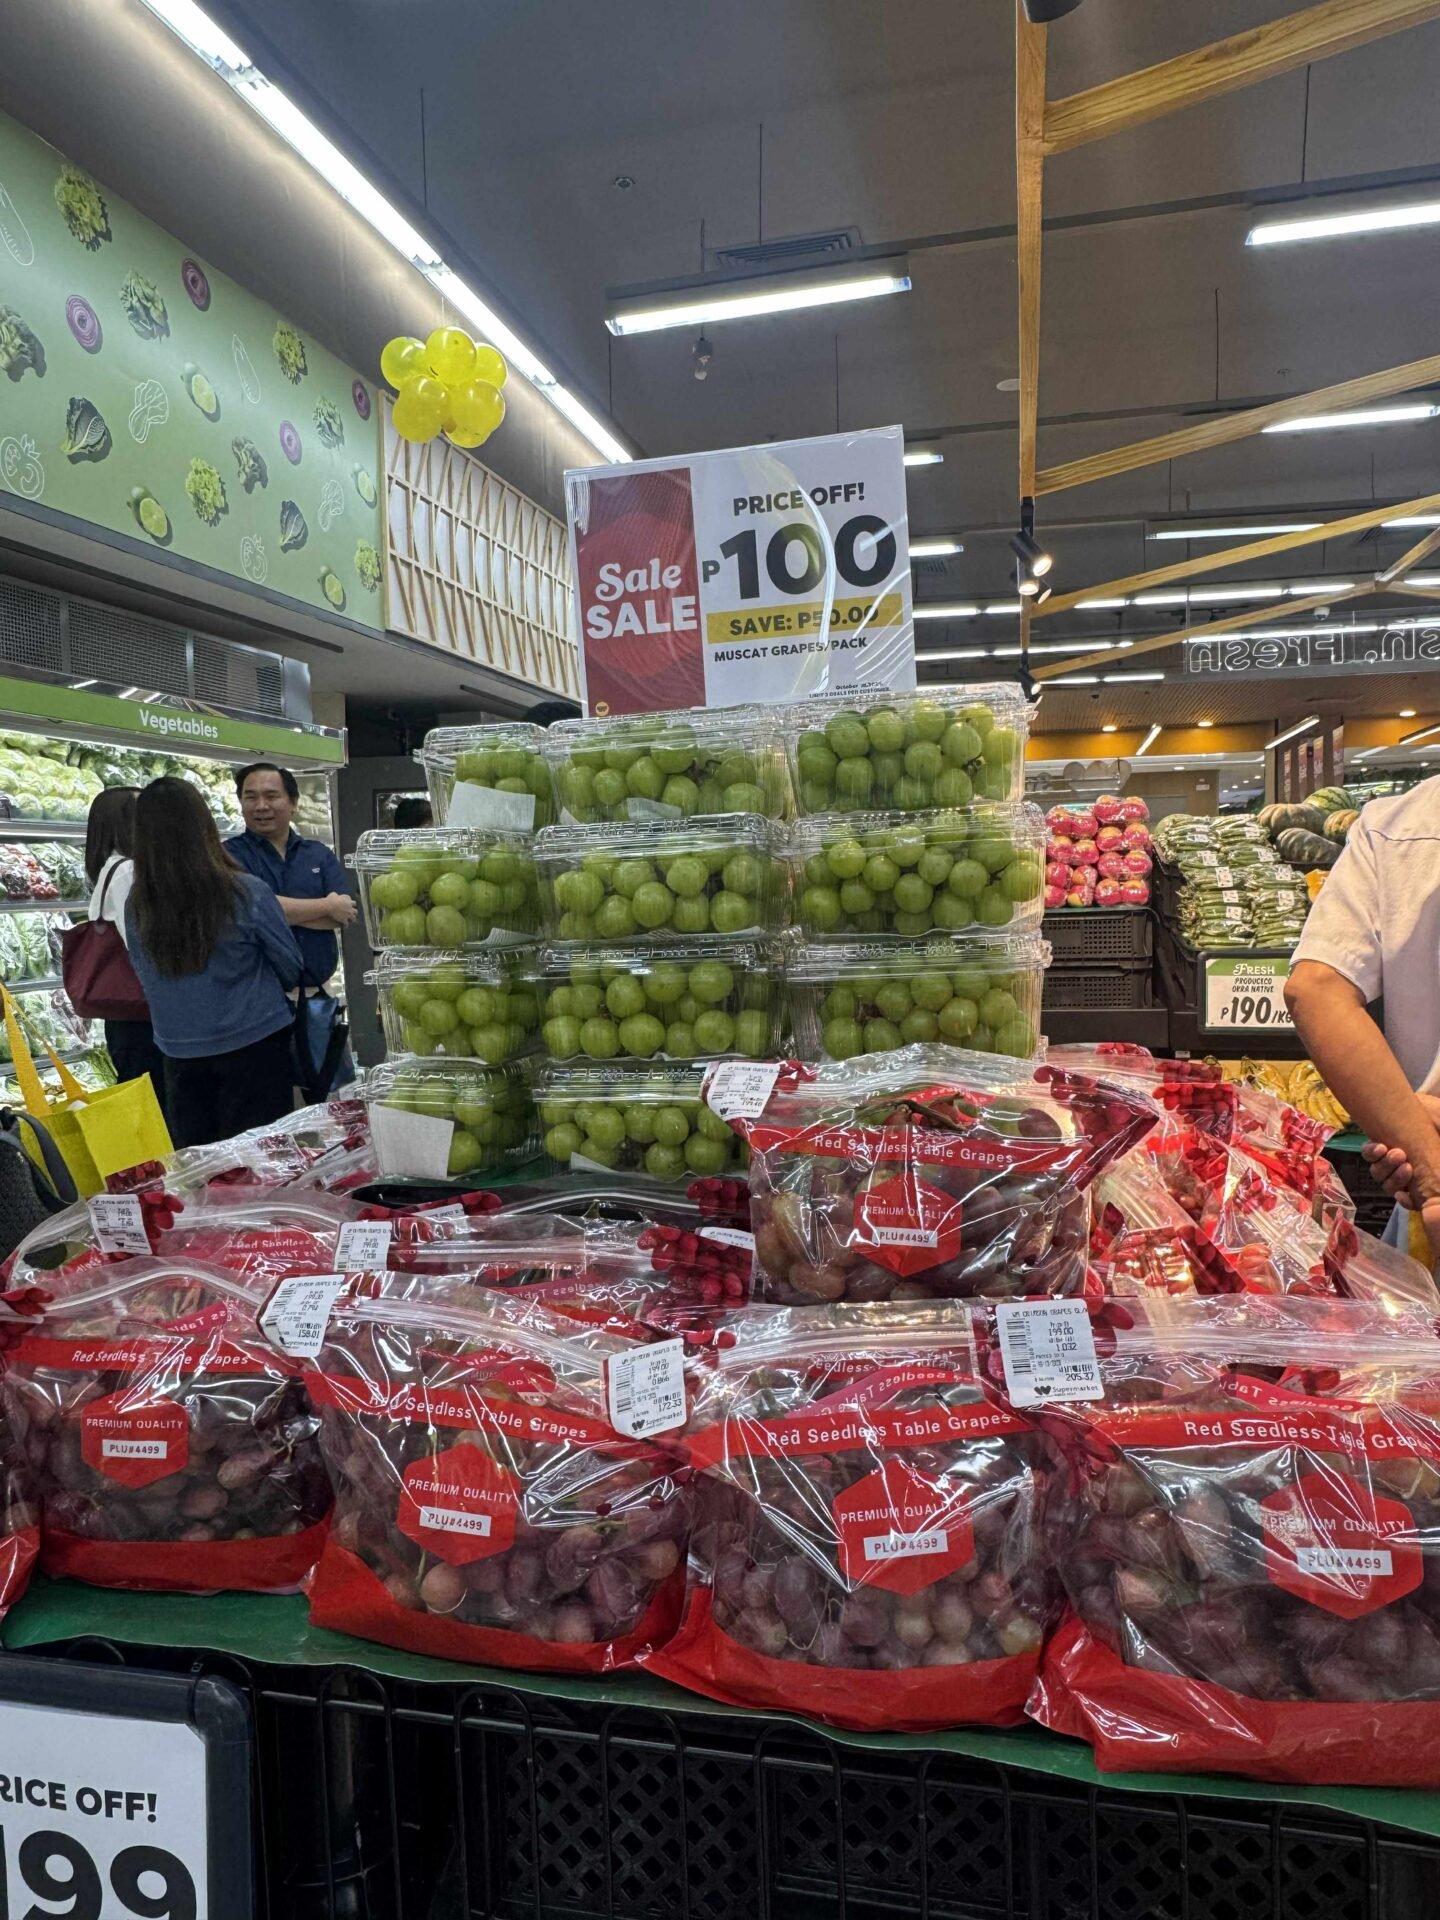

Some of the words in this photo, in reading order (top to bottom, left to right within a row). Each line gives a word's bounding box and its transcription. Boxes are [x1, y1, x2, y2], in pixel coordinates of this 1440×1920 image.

[733, 490, 804, 516] PRICE
[810, 482, 865, 506] OFF!
[596, 558, 682, 602] Sale
[587, 596, 698, 640] SALE
[730, 614, 792, 636] SAVE:
[714, 647, 768, 662] MUSCAT
[771, 637, 868, 656] GRAPES/PACK
[139, 709, 218, 738] Vegetables
[1232, 985, 1250, 993] OKRA
[1250, 985, 1274, 993] NATIVE
[814, 1136, 842, 1150] Red
[915, 1143, 954, 1158] Table
[960, 1149, 1014, 1165] Grapes
[860, 1205, 904, 1216] PREMIUM
[908, 1208, 956, 1220] QUALITY
[879, 1231, 930, 1244] PLU#4499
[72, 1350, 94, 1363] Red
[1052, 1385, 1099, 1394] Supermarket
[86, 1418, 132, 1429] PREMIUM
[136, 1420, 184, 1429] QUALITY
[405, 1396, 472, 1419] Seedless
[480, 1407, 523, 1428] Table
[530, 1417, 588, 1438] Grapes
[767, 1430, 800, 1446] Red
[893, 1418, 941, 1437] Table
[948, 1413, 1011, 1431] Grapes
[1184, 1421, 1223, 1437] Red
[1231, 1421, 1322, 1440] Seedless
[109, 1444, 160, 1454] PLU#4499
[408, 1479, 460, 1496] PREMIUM
[463, 1487, 513, 1503] QUALITY
[428, 1512, 483, 1531] PLU#4499
[841, 1507, 900, 1523] PREMIUM
[1343, 1519, 1406, 1533] QUALITY
[874, 1537, 938, 1554] PLU#4499
[75, 1786, 157, 1823] OFF!
